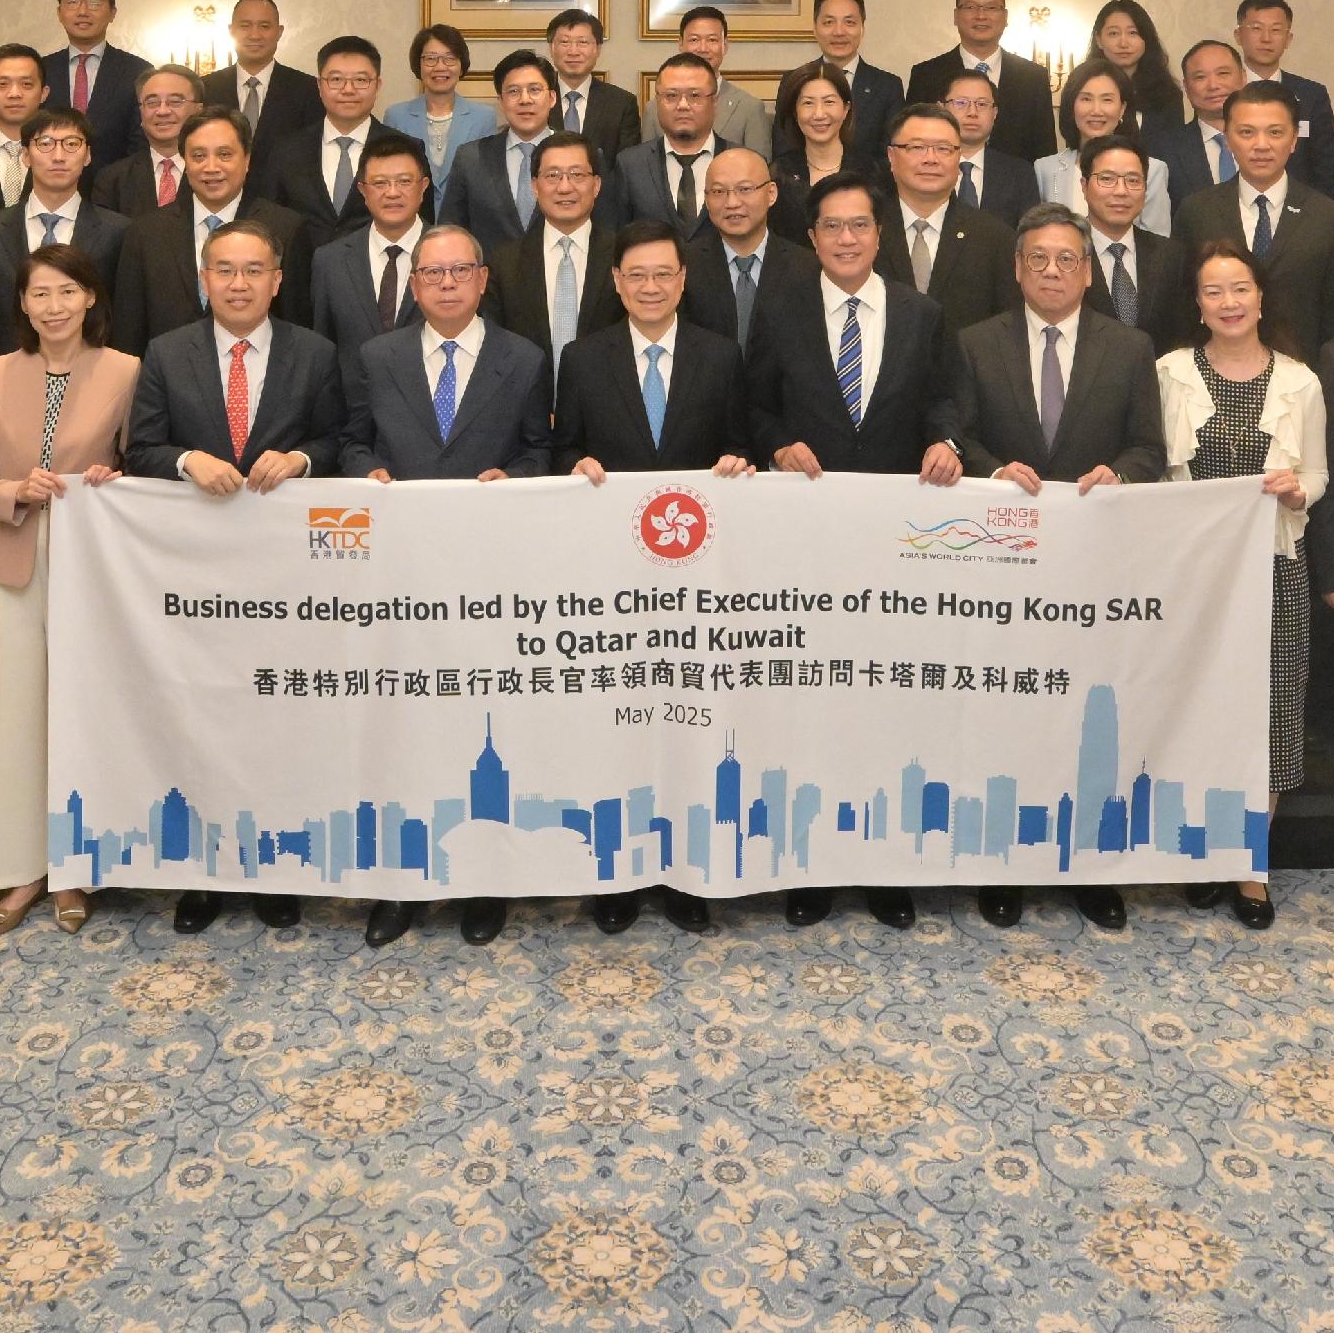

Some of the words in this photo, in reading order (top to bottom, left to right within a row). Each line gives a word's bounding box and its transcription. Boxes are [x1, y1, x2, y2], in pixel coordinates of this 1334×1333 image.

[987, 507, 1028, 517] HONG
[987, 517, 1028, 528] KONG
[309, 530, 370, 549] HKTDC
[929, 553, 961, 562] WORLD
[164, 593, 288, 619] Business
[297, 595, 449, 627] delegation
[459, 594, 503, 620] led
[513, 594, 548, 624] by
[556, 592, 605, 617] the
[613, 587, 688, 615] Chief
[696, 588, 833, 613] Executive
[842, 588, 873, 613] of
[879, 590, 928, 615] the
[937, 593, 1013, 625] Hong
[1023, 596, 1096, 627] Kong
[1105, 597, 1164, 622] SAR
[516, 632, 546, 656] to
[555, 630, 638, 659] Qatar
[646, 624, 697, 651] and
[708, 624, 806, 652] Kuwait
[252, 659, 1071, 697] 香港特別行政區行政長官率領商貿代表團訪問卡塔爾及科威特
[615, 706, 655, 726] May
[663, 702, 712, 727] 2025
